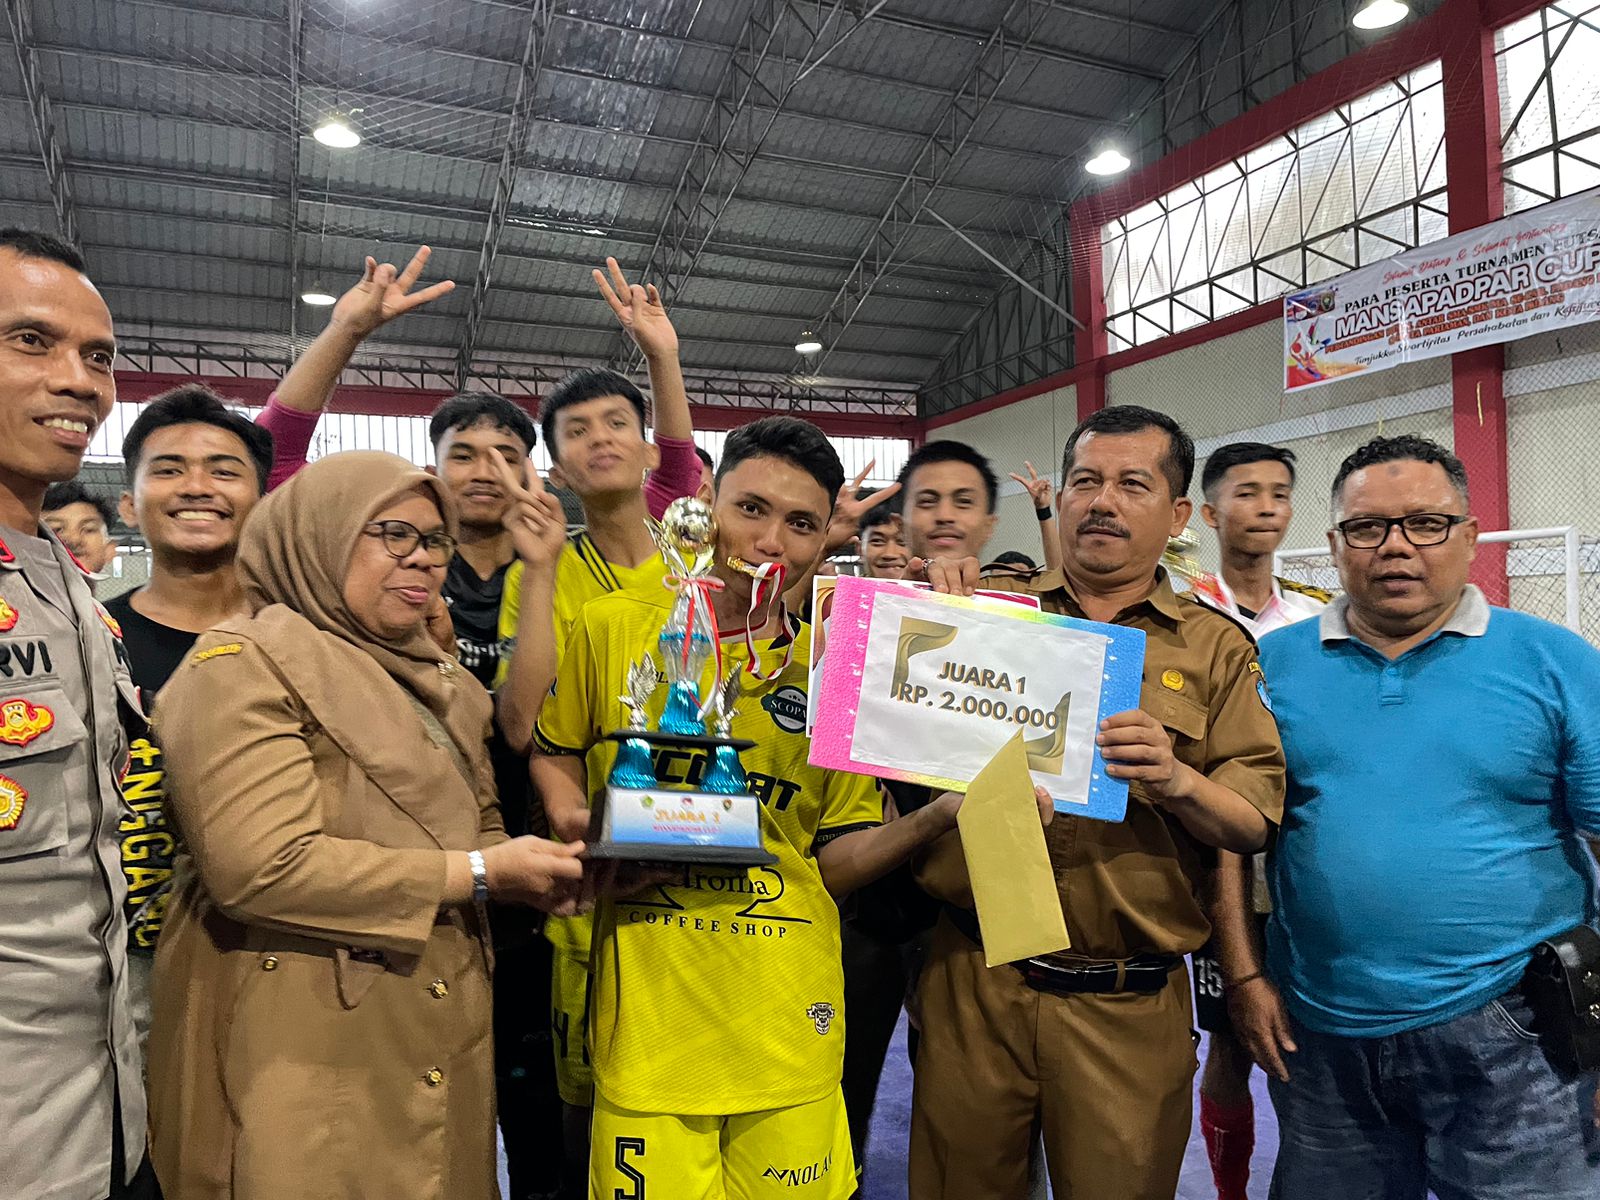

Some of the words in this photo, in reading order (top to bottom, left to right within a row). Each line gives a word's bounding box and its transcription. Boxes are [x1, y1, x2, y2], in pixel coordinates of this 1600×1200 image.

[1345, 293, 1381, 313] PARA
[1385, 273, 1450, 300] PESERTA
[1456, 243, 1547, 279] TURNAMEN
[1553, 228, 1600, 252] FUTS
[1335, 263, 1531, 341] MANSAPADPAR
[1535, 242, 1600, 283] CUP
[1457, 317, 1528, 340] Persahabatan
[1531, 311, 1550, 322] dan
[937, 661, 1012, 693] JUARA
[1015, 676, 1027, 695] 1
[896, 682, 934, 708] RP.
[938, 691, 1061, 731] 2.000.000
[683, 863, 771, 896] roma
[628, 910, 721, 933] COFFEE
[730, 922, 787, 938] SHOP
[614, 1136, 646, 1200] 5
